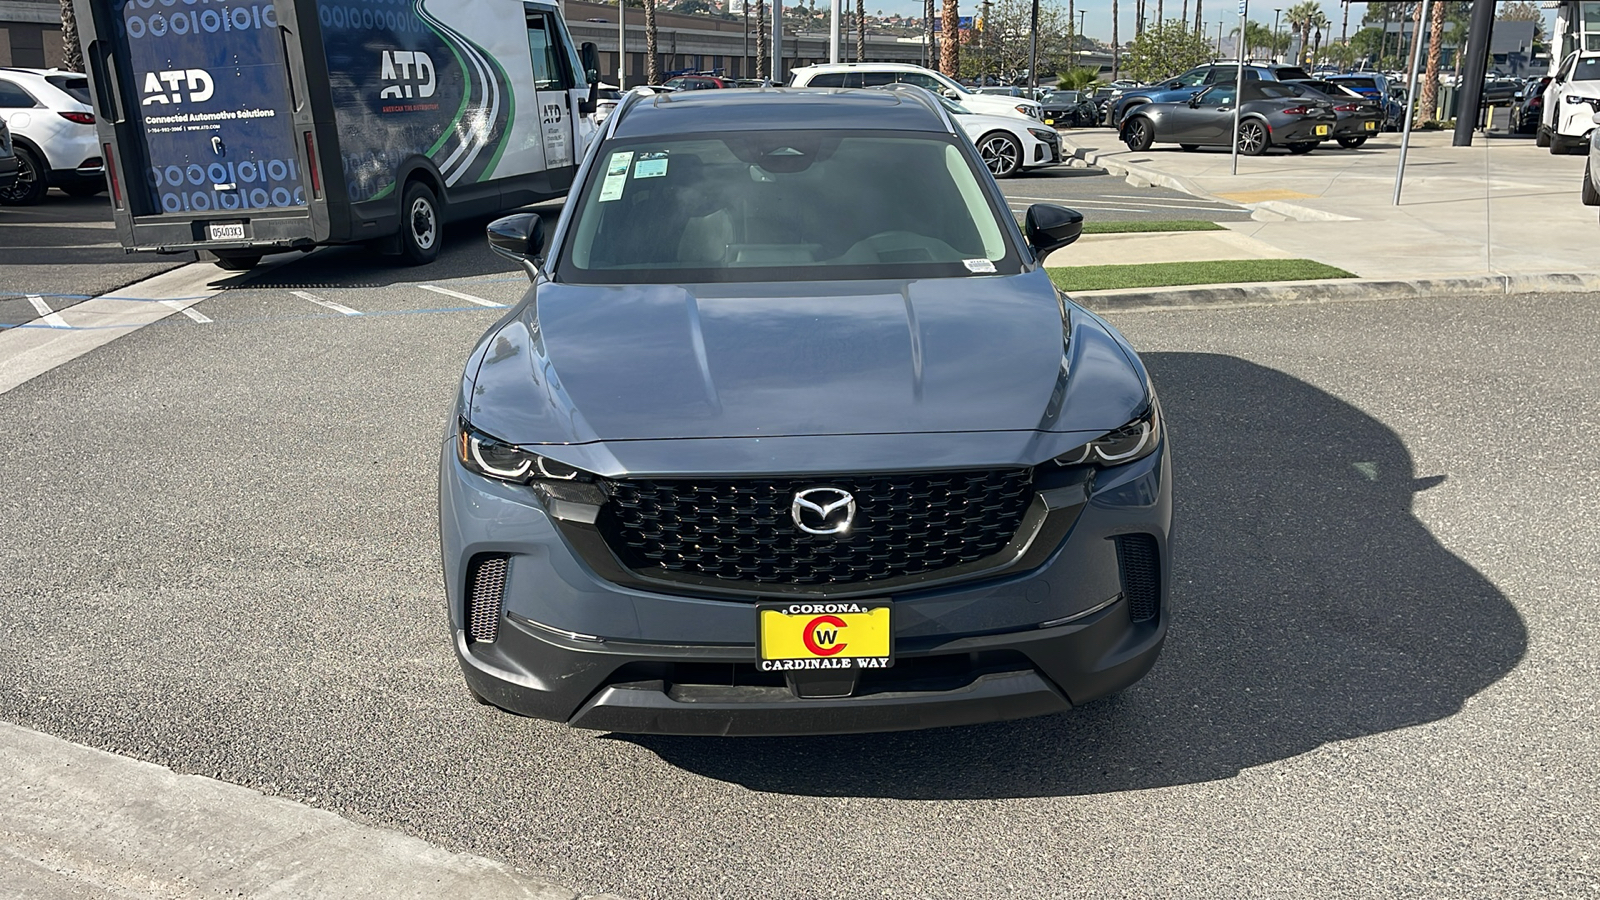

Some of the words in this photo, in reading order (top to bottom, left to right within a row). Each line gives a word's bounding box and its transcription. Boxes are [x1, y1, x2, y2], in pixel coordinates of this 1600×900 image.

[381, 51, 436, 99] ATD
[142, 69, 215, 105] ATD
[145, 113, 188, 124] Connected
[189, 110, 236, 122] Automotive
[237, 108, 275, 119] Solutions
[543, 104, 562, 124] ATD
[789, 603, 861, 614] CORONA
[762, 658, 851, 671] CARDINALE
[856, 657, 889, 668] WAY
